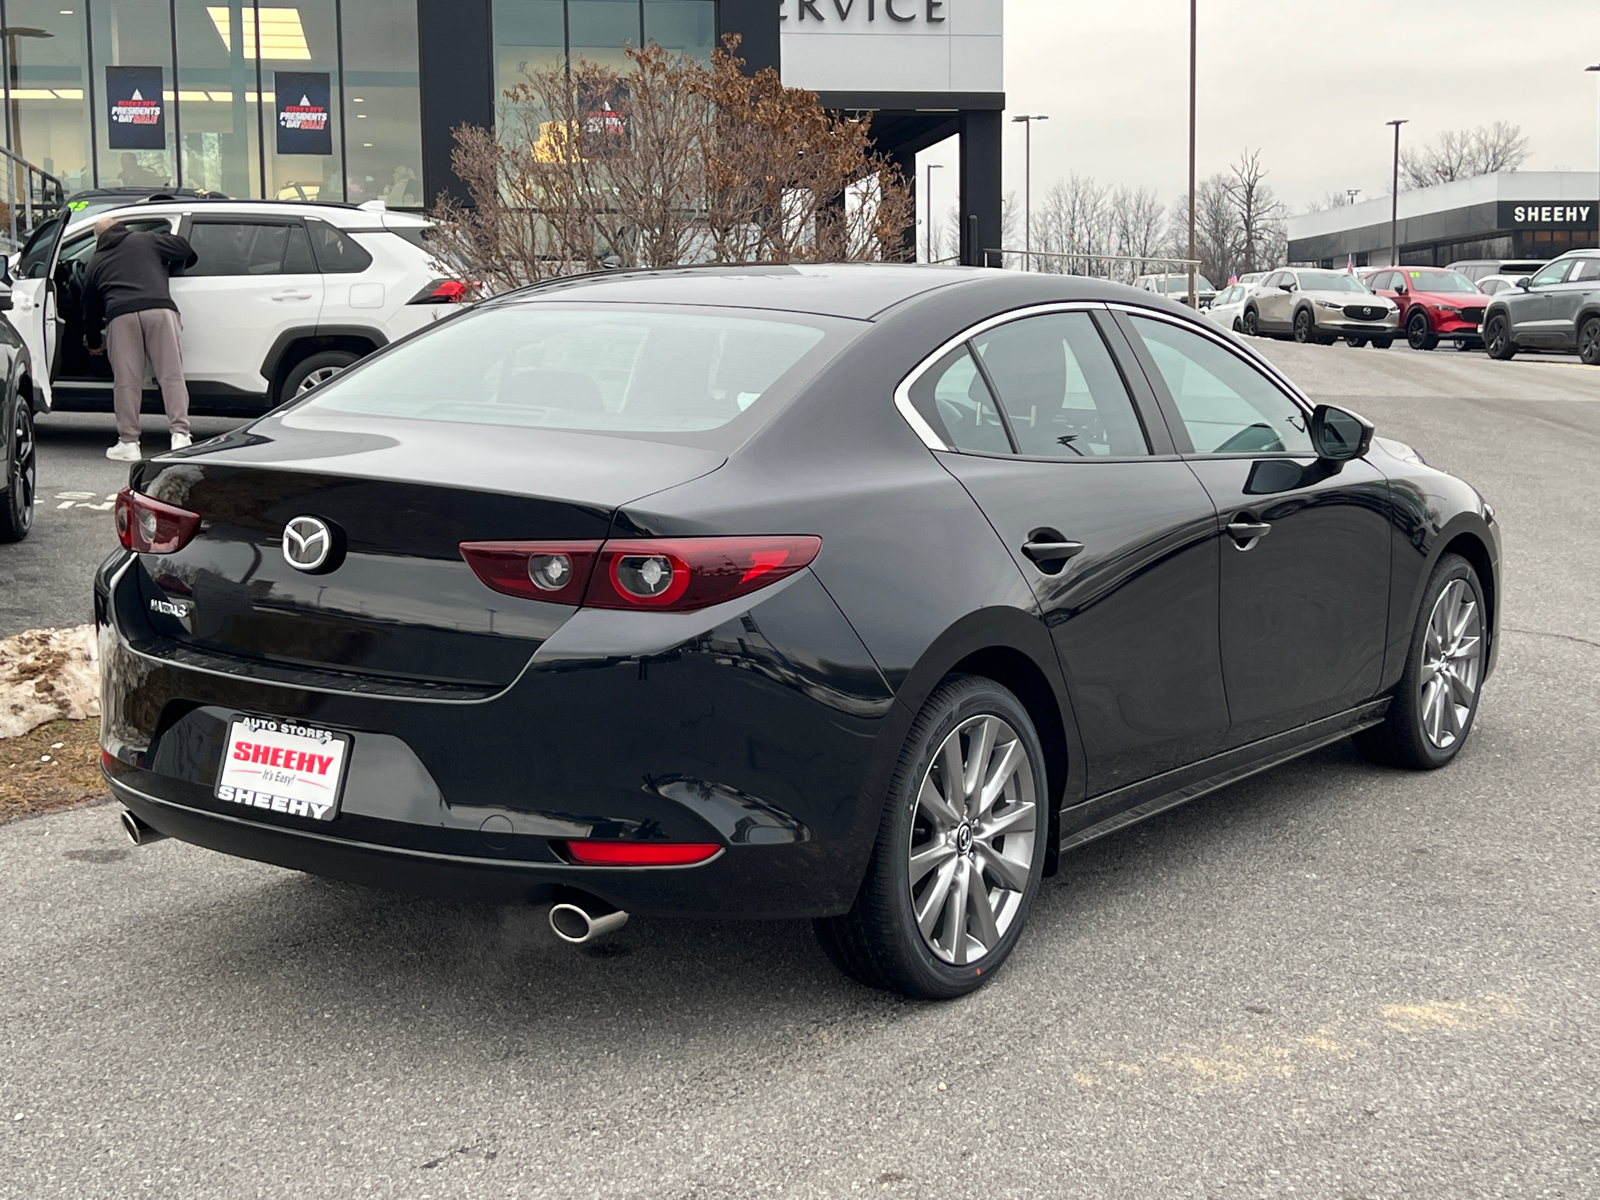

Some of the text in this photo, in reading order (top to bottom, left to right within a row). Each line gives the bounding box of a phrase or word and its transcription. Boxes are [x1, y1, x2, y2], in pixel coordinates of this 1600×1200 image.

[111, 106, 161, 116] PRESIDENTS
[280, 111, 328, 122] PRESIDENTS
[118, 114, 158, 125] DAY SALE
[286, 119, 326, 130] DAY SALE
[1513, 206, 1590, 222] SHEEHY
[242, 717, 333, 741] AUTO STORES
[233, 741, 335, 775] SHEEHY
[262, 769, 296, 786] It's Easy!
[218, 784, 330, 820] SHEEHY
